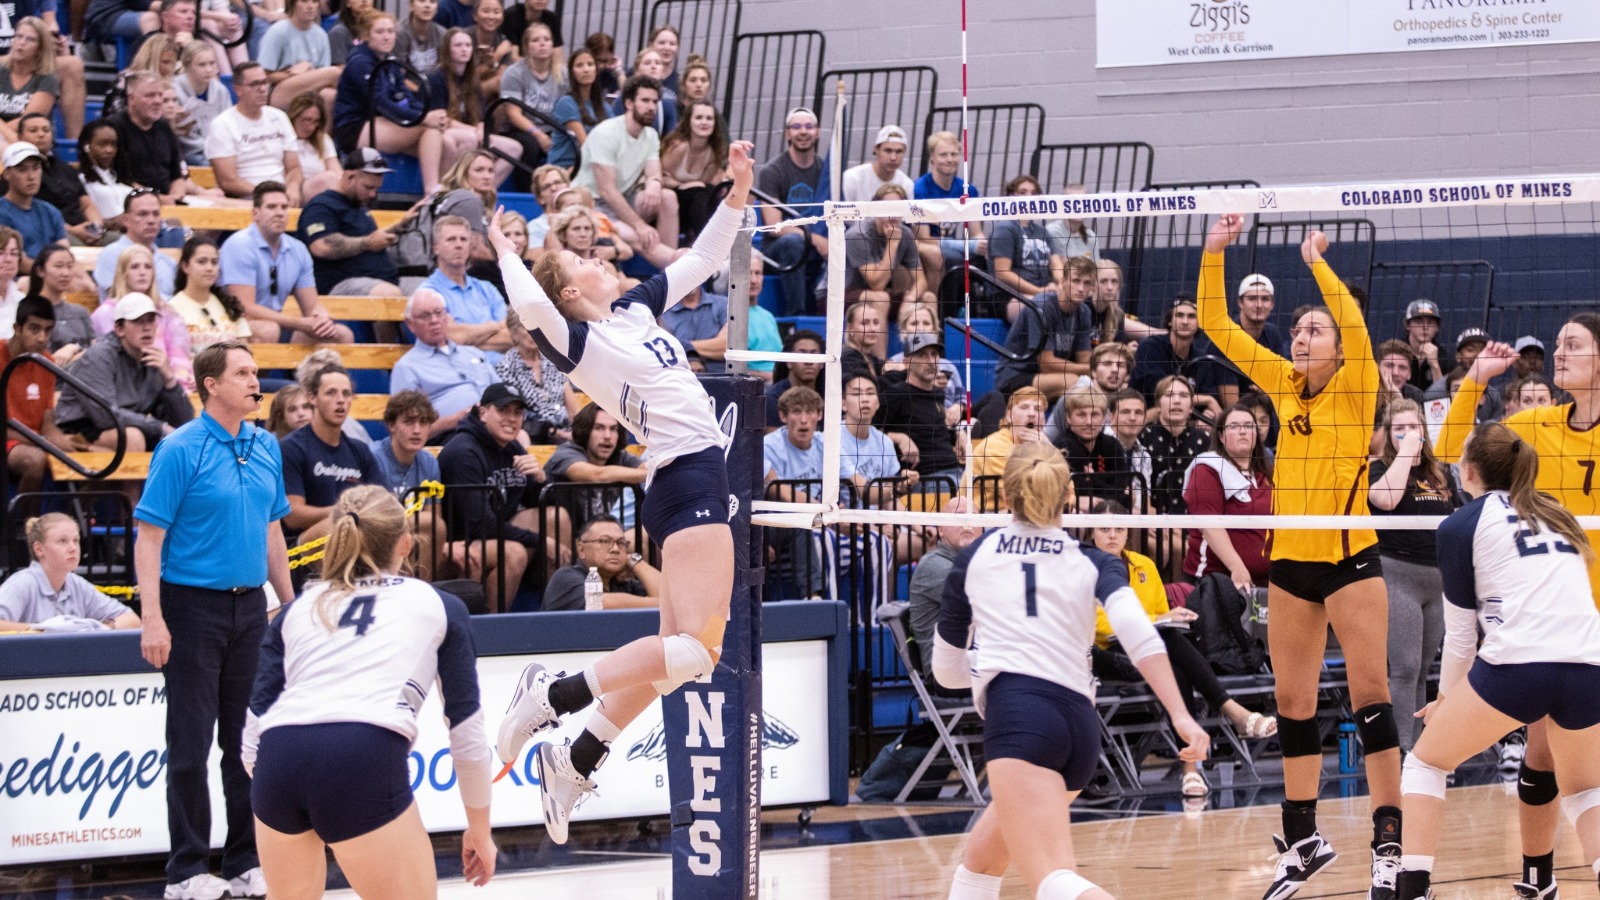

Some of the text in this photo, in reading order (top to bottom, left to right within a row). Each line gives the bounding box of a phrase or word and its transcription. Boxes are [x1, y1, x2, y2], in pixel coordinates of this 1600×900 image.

[1189, 2, 1250, 31] Ziggi's
[1393, 11, 1563, 32] Orthopedics & Spine Center
[1168, 42, 1273, 56] West Colfax & Garrison
[1195, 31, 1245, 43] COFFEE
[1407, 33, 1487, 45] panoramaortho.com
[1498, 29, 1550, 40] 303-233-1223
[982, 195, 1197, 217] COLORADO SCHOOL OF MINES
[1341, 182, 1572, 206] COLORADO SCHOOL OF MINES
[643, 337, 679, 369] 13
[1577, 460, 1596, 496] 7
[1507, 515, 1579, 557] 2
[1021, 562, 1038, 616] 1
[338, 594, 377, 636] 4
[44, 688, 117, 711] SCHOOL
[123, 687, 148, 706] OF
[0, 732, 167, 821] edigge
[684, 690, 725, 876] NES
[749, 713, 758, 897] #HELLUVAENGINEER
[11, 828, 142, 848] MINESATHLETICS.COM
